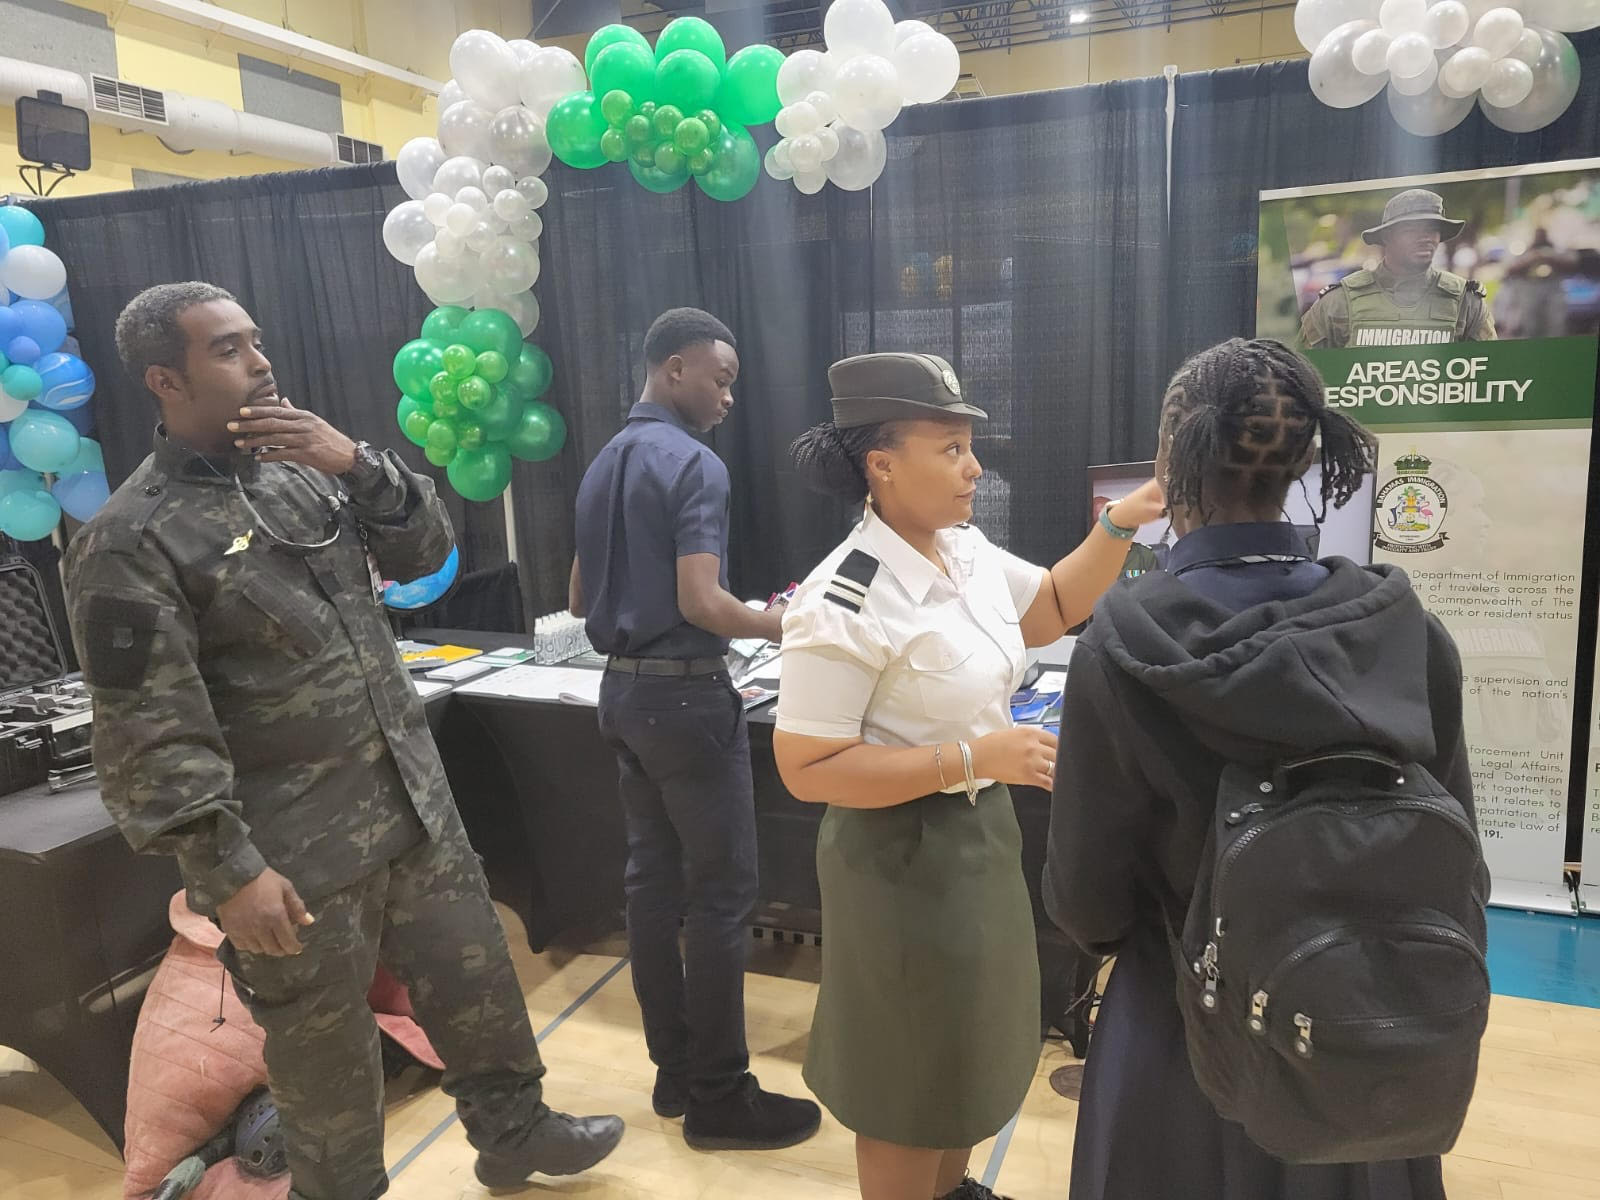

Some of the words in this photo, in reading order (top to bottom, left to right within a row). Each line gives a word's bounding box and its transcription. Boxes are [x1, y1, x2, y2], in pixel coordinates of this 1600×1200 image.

[1356, 328, 1451, 346] IMMIGRATION
[1346, 359, 1440, 384] AREAS
[1446, 357, 1489, 379] OF
[1323, 379, 1533, 408] ESPONSIBILITY
[1377, 479, 1405, 503] BAHAMAS
[1407, 476, 1446, 503] IMMIGRATION
[1412, 570, 1482, 581] Department
[1487, 571, 1500, 580] of
[1503, 572, 1575, 584] Immigration
[1430, 582, 1442, 591] of
[1449, 582, 1500, 593] travelers
[1508, 586, 1547, 594] across
[1555, 584, 1575, 594] the
[1428, 595, 1522, 606] Commonwealth
[1531, 596, 1544, 607] of
[1552, 597, 1574, 607] The
[1437, 607, 1465, 617] work
[1468, 609, 1480, 617] or
[1484, 608, 1532, 619] resident
[1536, 610, 1573, 620] status
[1474, 676, 1540, 685] supervision
[1545, 677, 1569, 687] and
[1469, 685, 1481, 695] of
[1492, 687, 1511, 697] the
[1522, 689, 1568, 699] nation's
[1470, 746, 1531, 757] forcement
[1540, 751, 1565, 761] Unit
[1481, 759, 1513, 770] Legal
[1521, 761, 1564, 773] Affairs,
[1472, 770, 1494, 779] and
[1504, 772, 1563, 784] Detention
[1493, 784, 1544, 796] together
[1550, 786, 1562, 796] to
[1491, 795, 1499, 804] it
[1504, 796, 1544, 807] relates
[1550, 799, 1561, 809] to
[1477, 807, 1538, 819] patriation
[1548, 810, 1561, 820] of
[1478, 818, 1516, 829] tatute
[1520, 820, 1544, 831] Law
[1547, 822, 1560, 832] of
[1483, 829, 1504, 839] 191.
